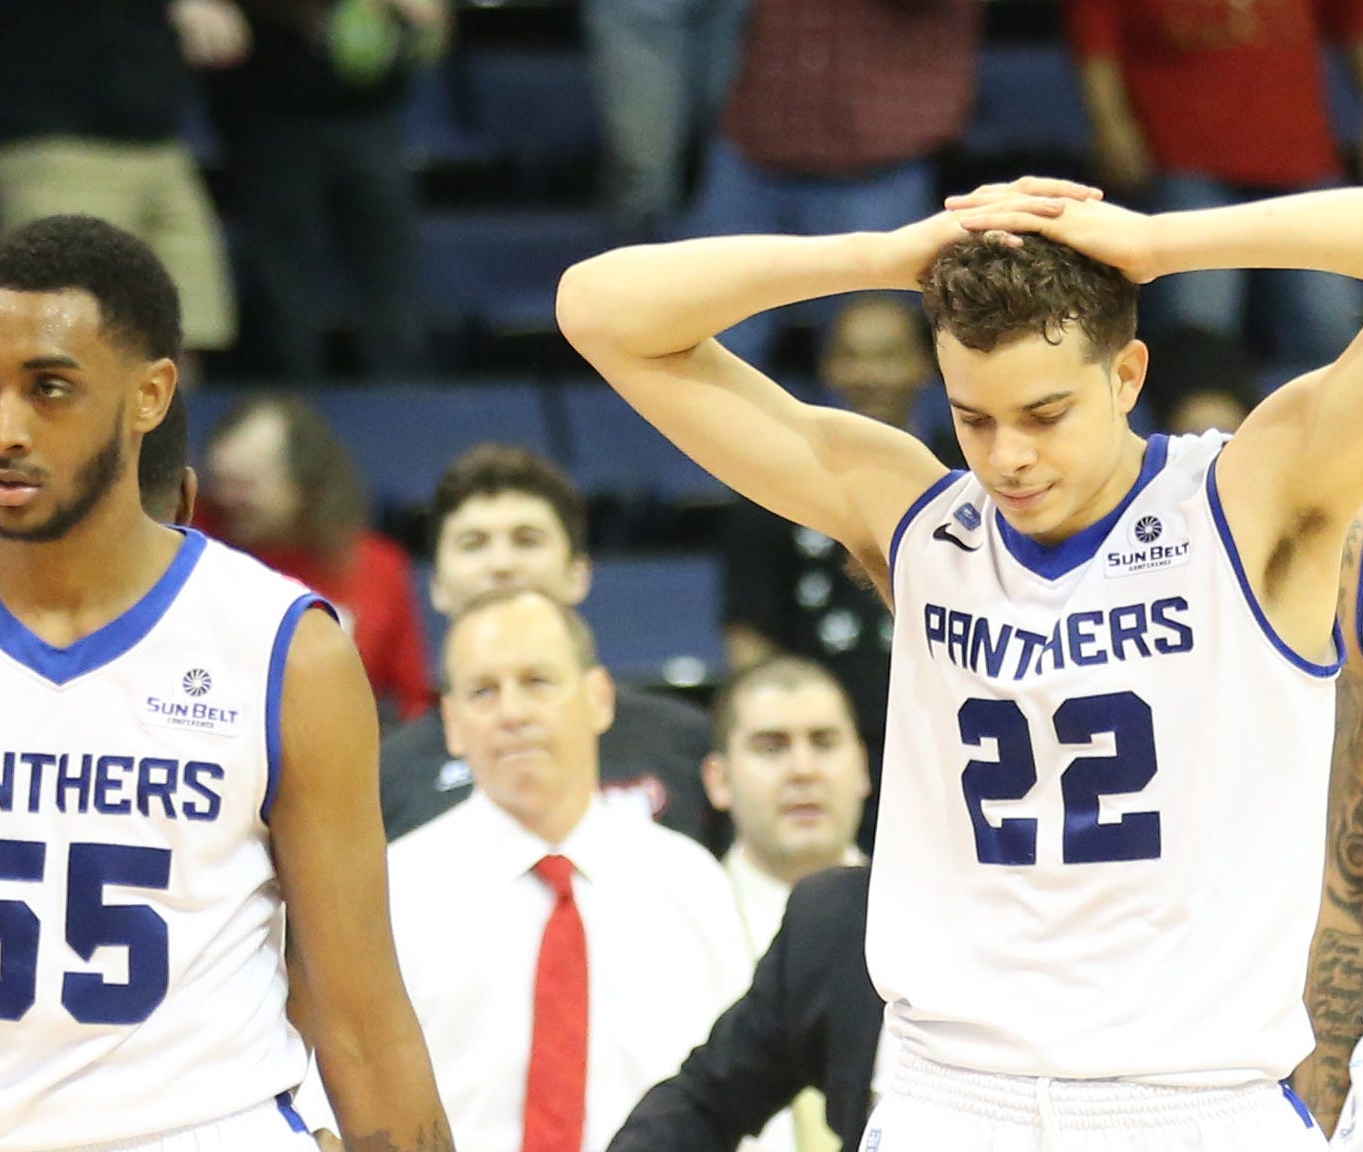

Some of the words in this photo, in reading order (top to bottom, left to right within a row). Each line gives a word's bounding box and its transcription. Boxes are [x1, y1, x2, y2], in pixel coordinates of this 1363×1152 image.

[1107, 551, 1146, 567] SUN
[1150, 541, 1190, 560] BELT
[924, 596, 1195, 682] PANTHERS
[146, 697, 189, 717] SUN
[192, 703, 239, 724] BELT
[957, 690, 1162, 866] 22
